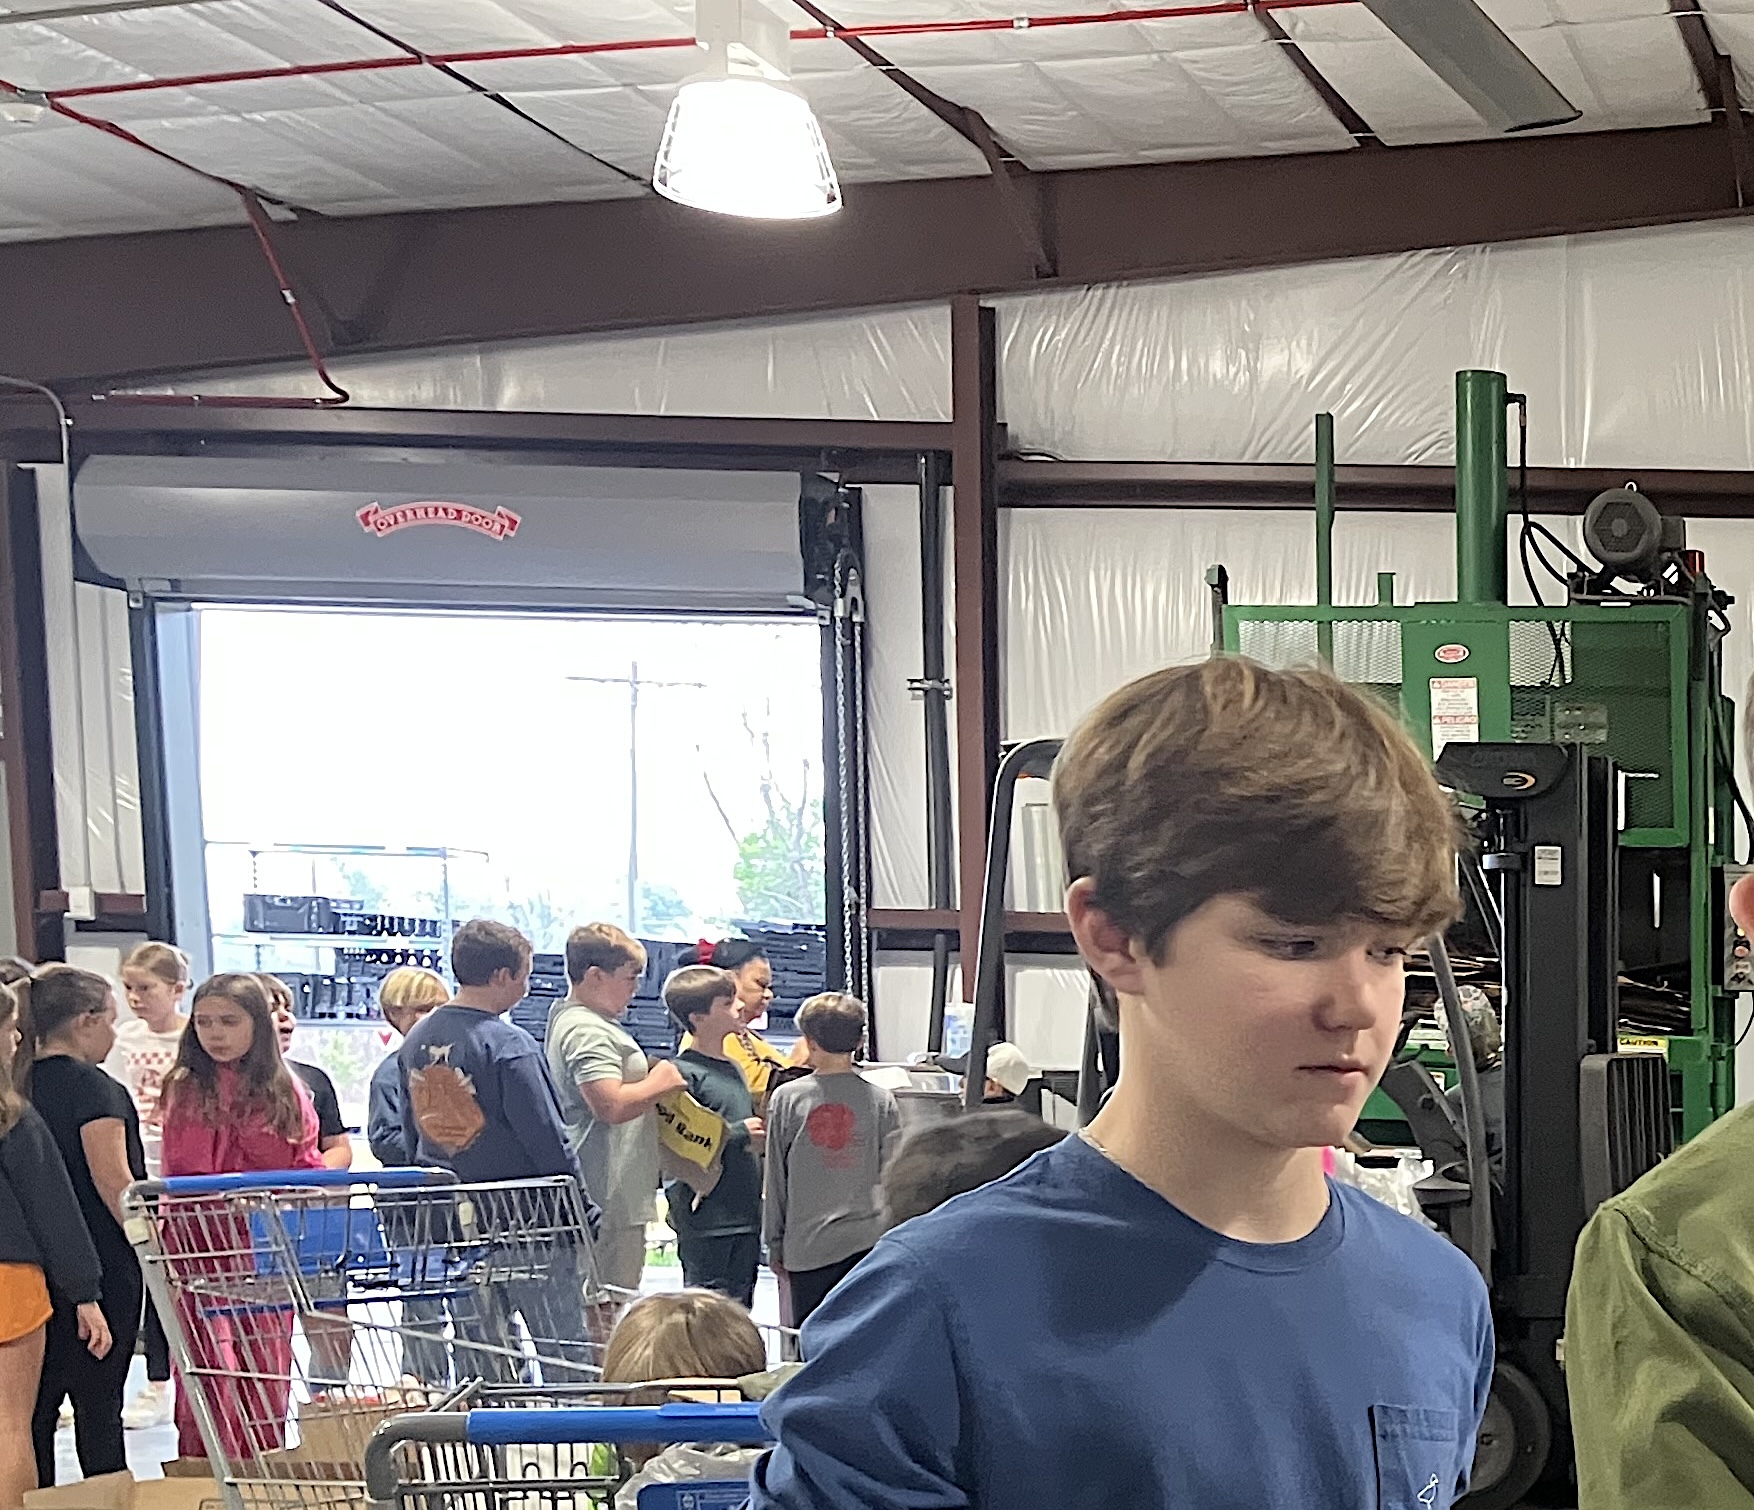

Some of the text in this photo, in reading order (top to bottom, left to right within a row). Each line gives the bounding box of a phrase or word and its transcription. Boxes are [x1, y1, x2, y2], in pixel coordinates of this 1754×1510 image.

[377, 507, 501, 534] OVERHEAD DOOR
[1619, 1037, 1659, 1048] CAUTION
